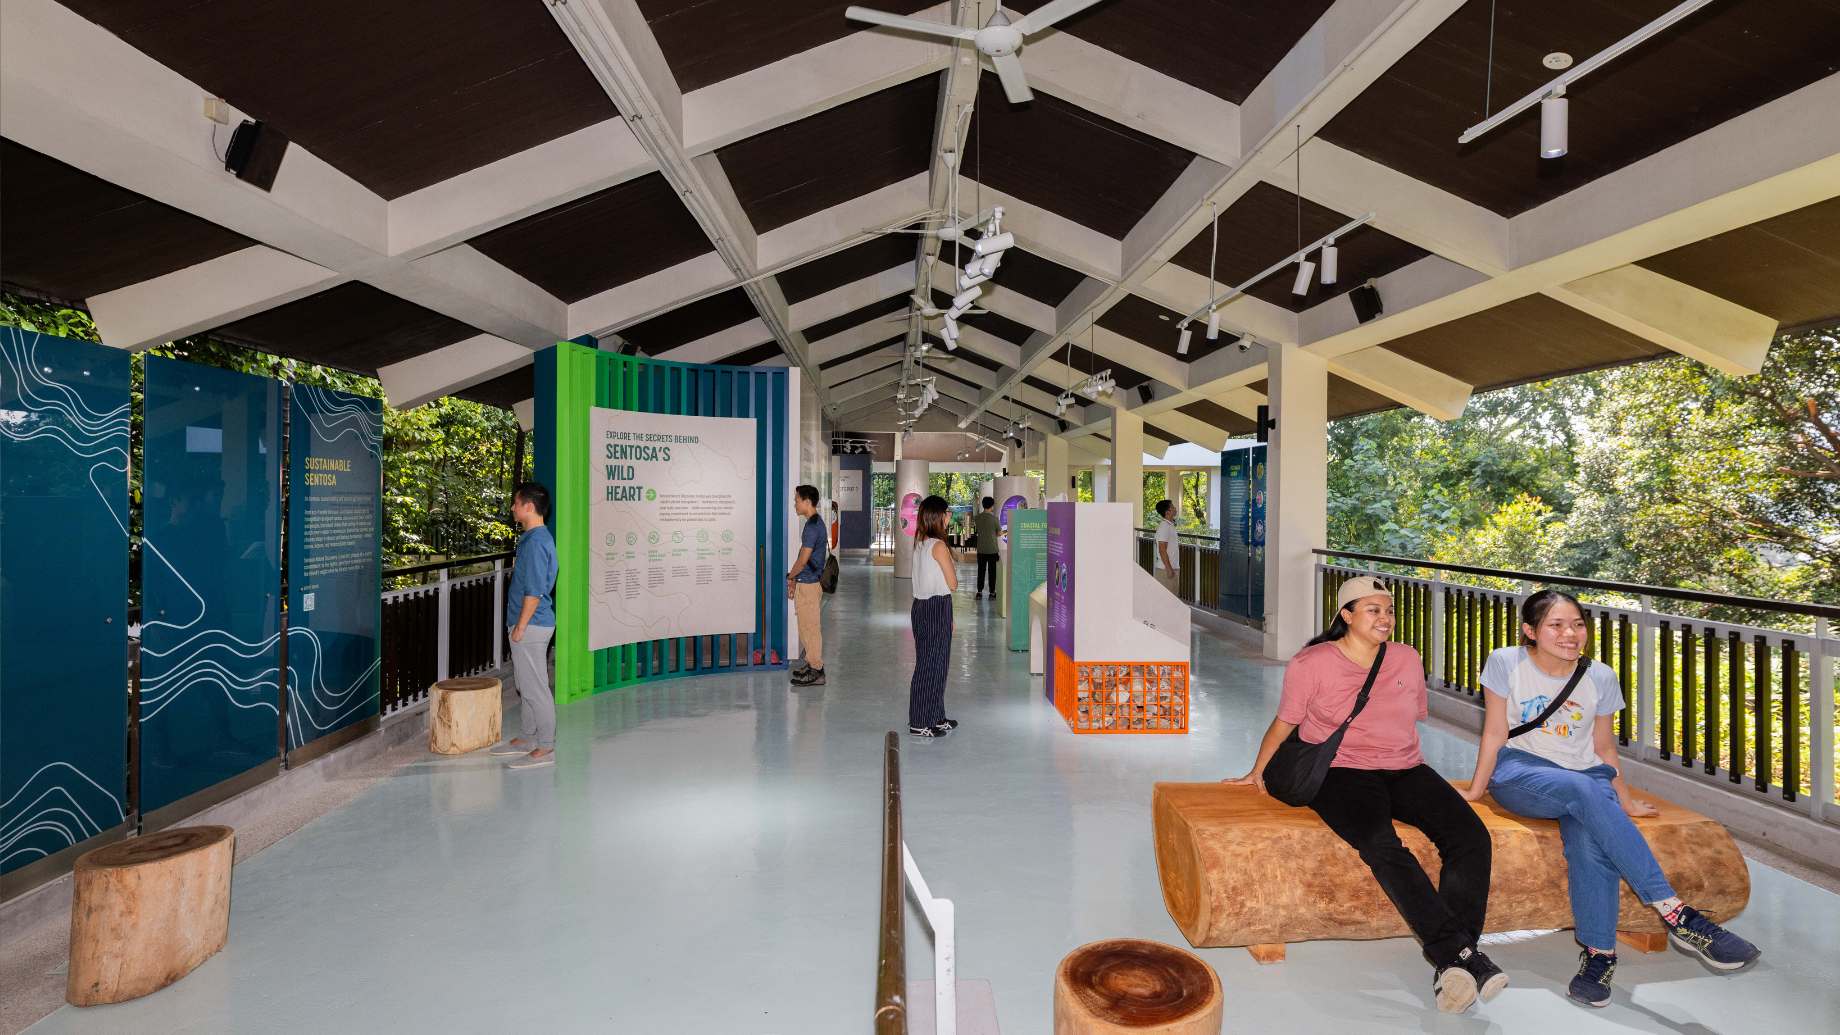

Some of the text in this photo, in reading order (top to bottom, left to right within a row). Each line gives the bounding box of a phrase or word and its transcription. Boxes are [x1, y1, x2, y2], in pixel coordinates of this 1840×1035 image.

[606, 430, 699, 444] EXPLORE THE SECRETS BEHIND
[606, 443, 671, 462] SENTOSA'S
[304, 457, 352, 472] SUSTAINABLE
[606, 464, 635, 481] WILD
[304, 473, 337, 486] SENTOSA
[606, 485, 643, 502] HEART
